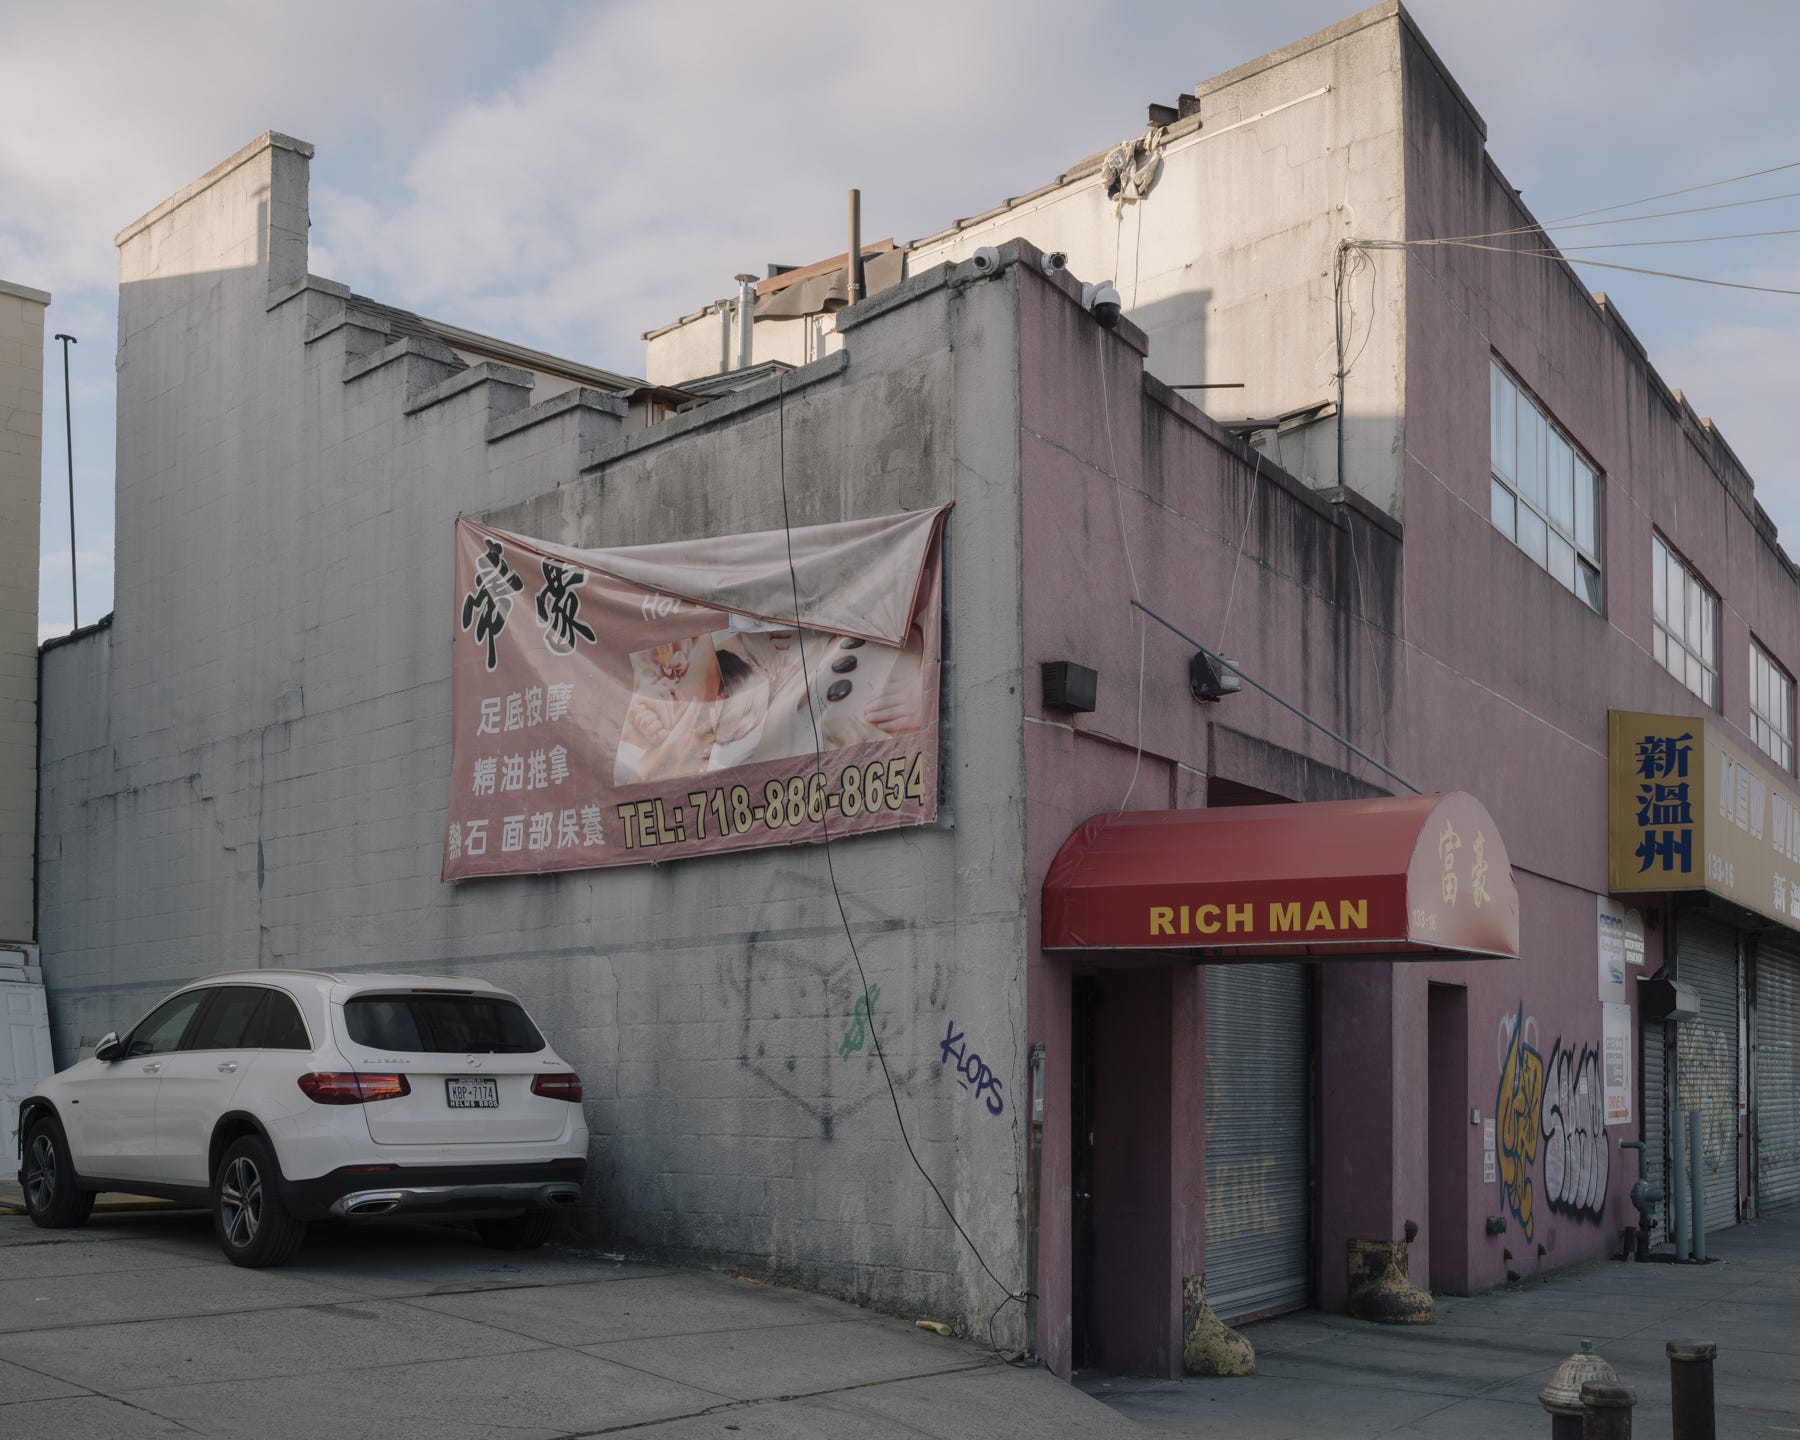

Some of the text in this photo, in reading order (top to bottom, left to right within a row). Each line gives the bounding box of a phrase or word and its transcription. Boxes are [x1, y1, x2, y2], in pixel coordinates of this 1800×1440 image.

[476, 682, 575, 737] 足底按摩
[472, 743, 570, 797] 精油推拿
[1719, 751, 1766, 840] NEW
[617, 751, 926, 849] TEL: 718-886-8654
[501, 803, 605, 852] 面部保養
[1438, 818, 1491, 910] 富豪
[1707, 853, 1734, 889] 133-16
[1149, 899, 1368, 936] RICH MAN
[1412, 909, 1437, 931] 133-16
[939, 1019, 1004, 1116] KLOPS
